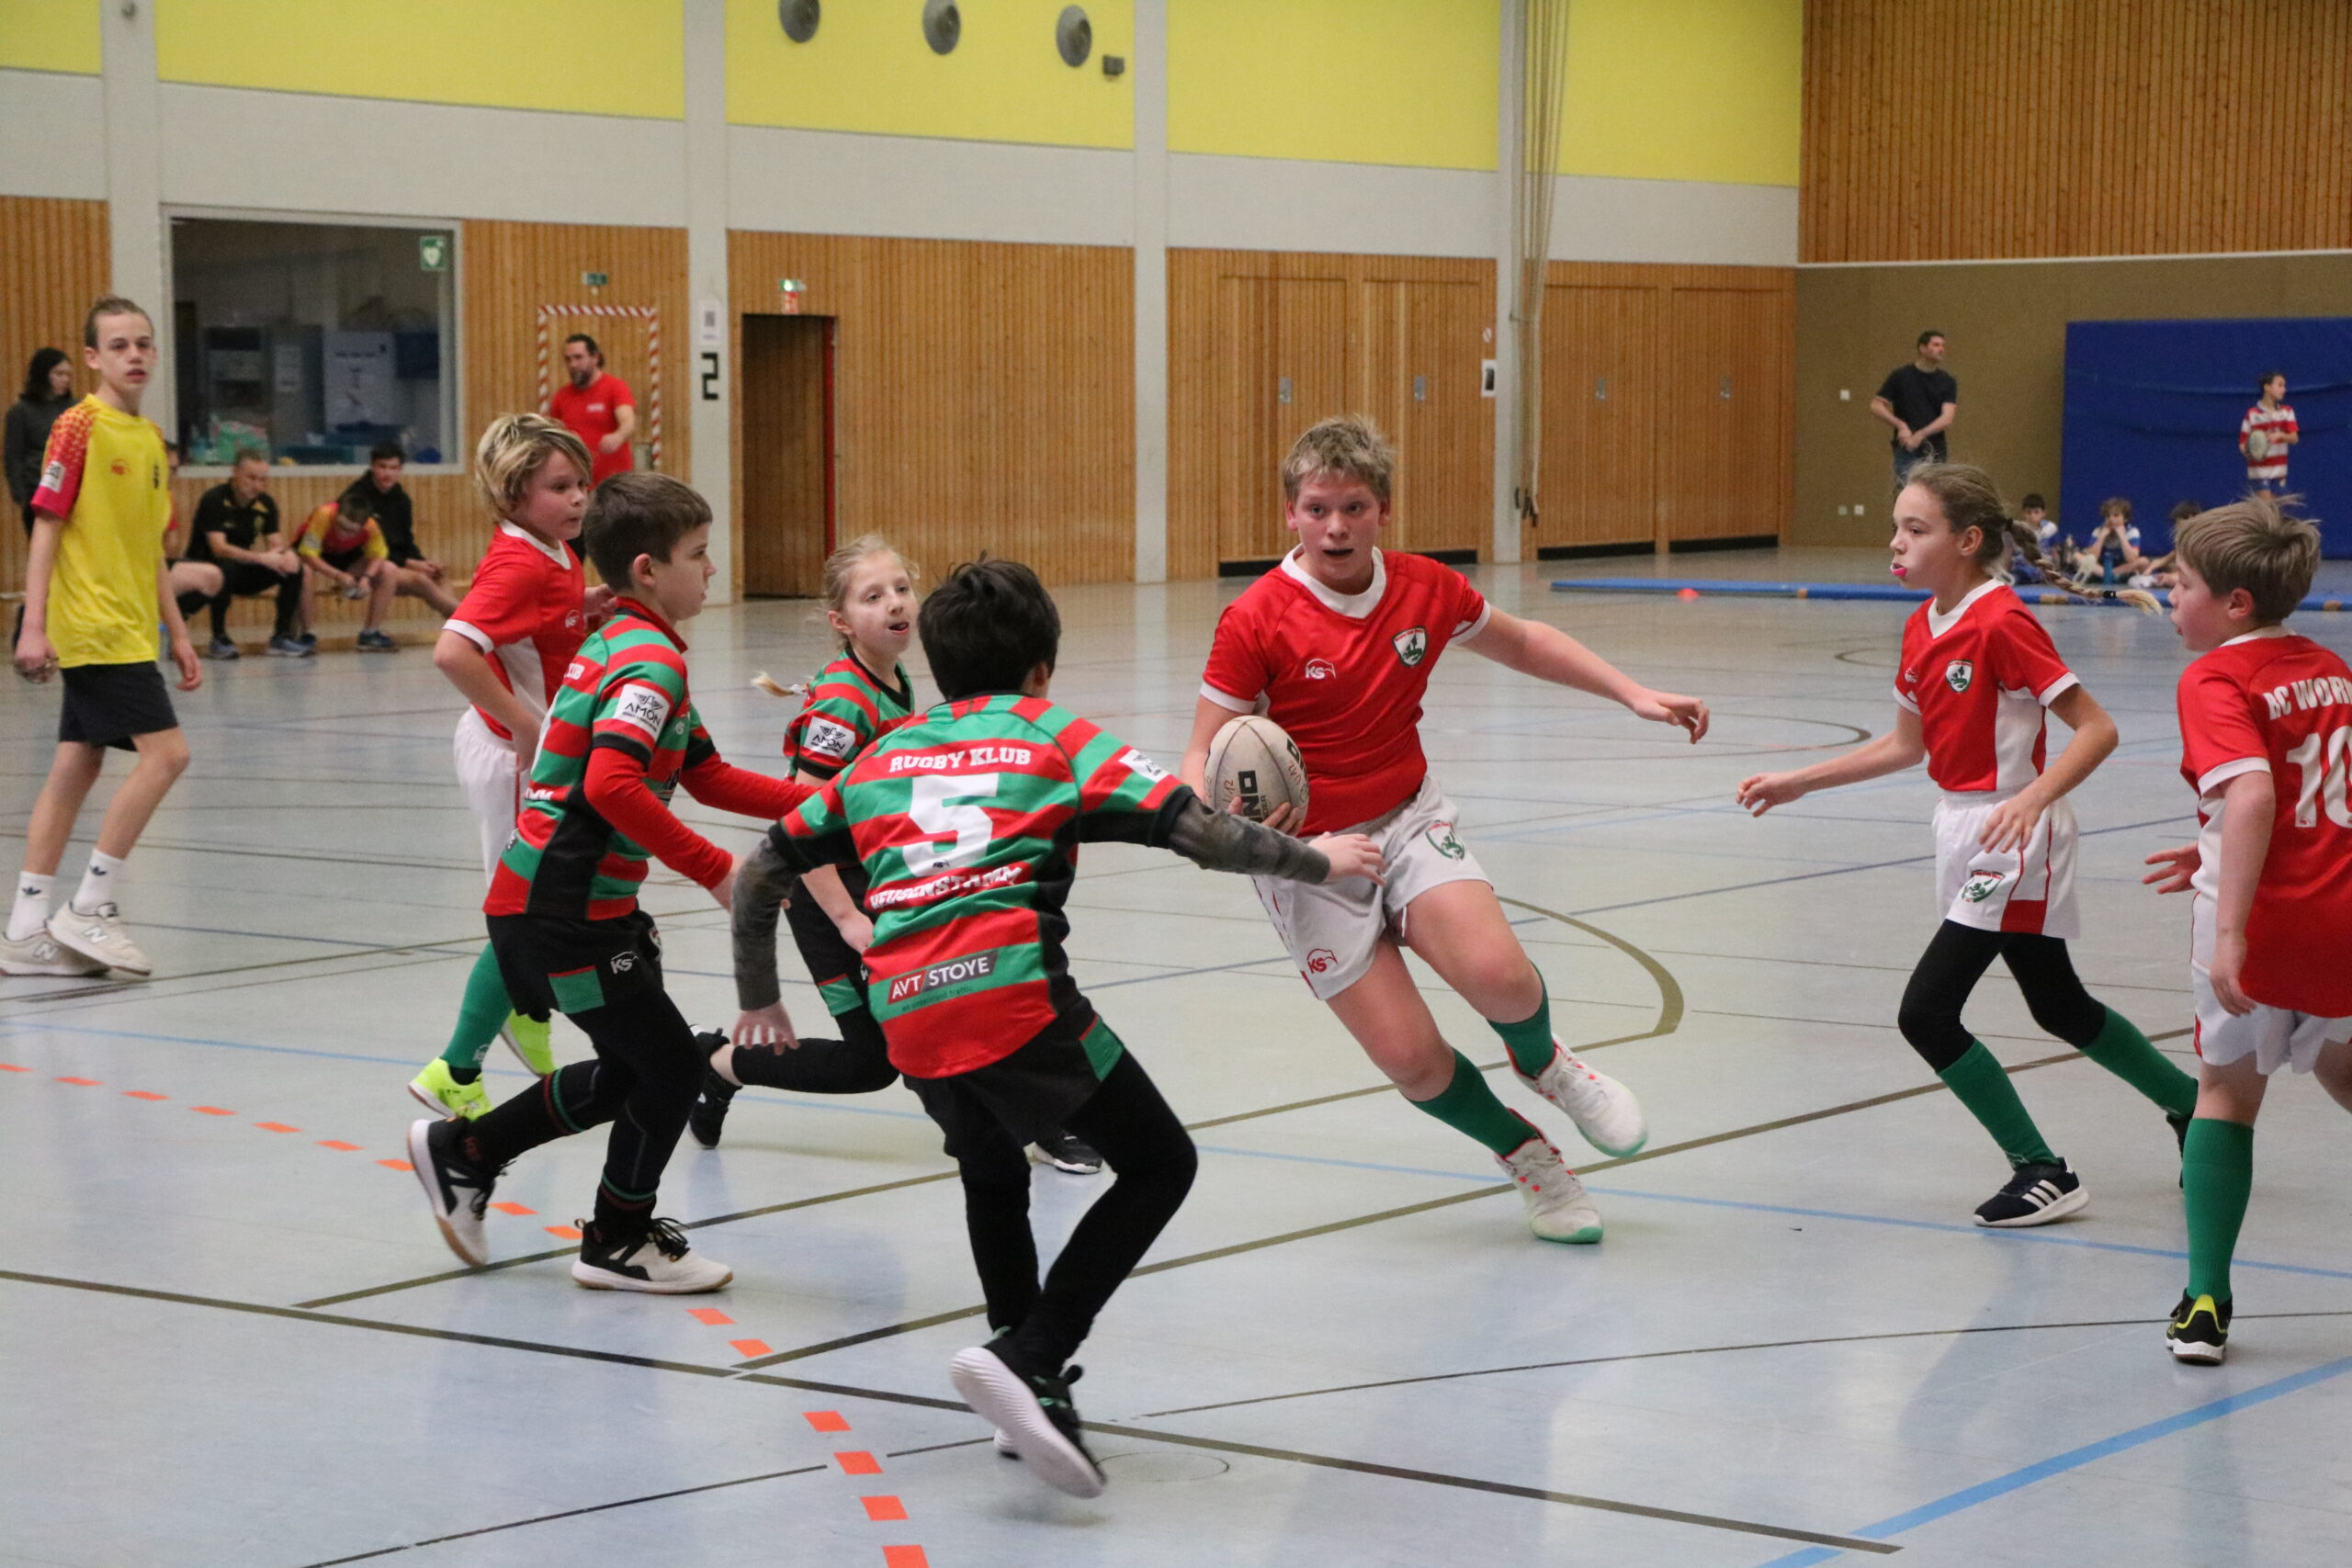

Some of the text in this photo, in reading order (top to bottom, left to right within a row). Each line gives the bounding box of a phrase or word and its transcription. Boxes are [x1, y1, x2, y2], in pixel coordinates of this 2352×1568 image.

[701, 353, 718, 400] 2
[2290, 676, 2352, 711] WOR
[625, 703, 661, 727] AMON
[812, 734, 845, 750] AMON
[889, 747, 1031, 773] RUGBY KLUB
[2286, 725, 2352, 829] 10
[902, 773, 1000, 878] 5
[610, 958, 632, 974] KS
[891, 975, 922, 999] AVT
[929, 957, 989, 987] STOYE
